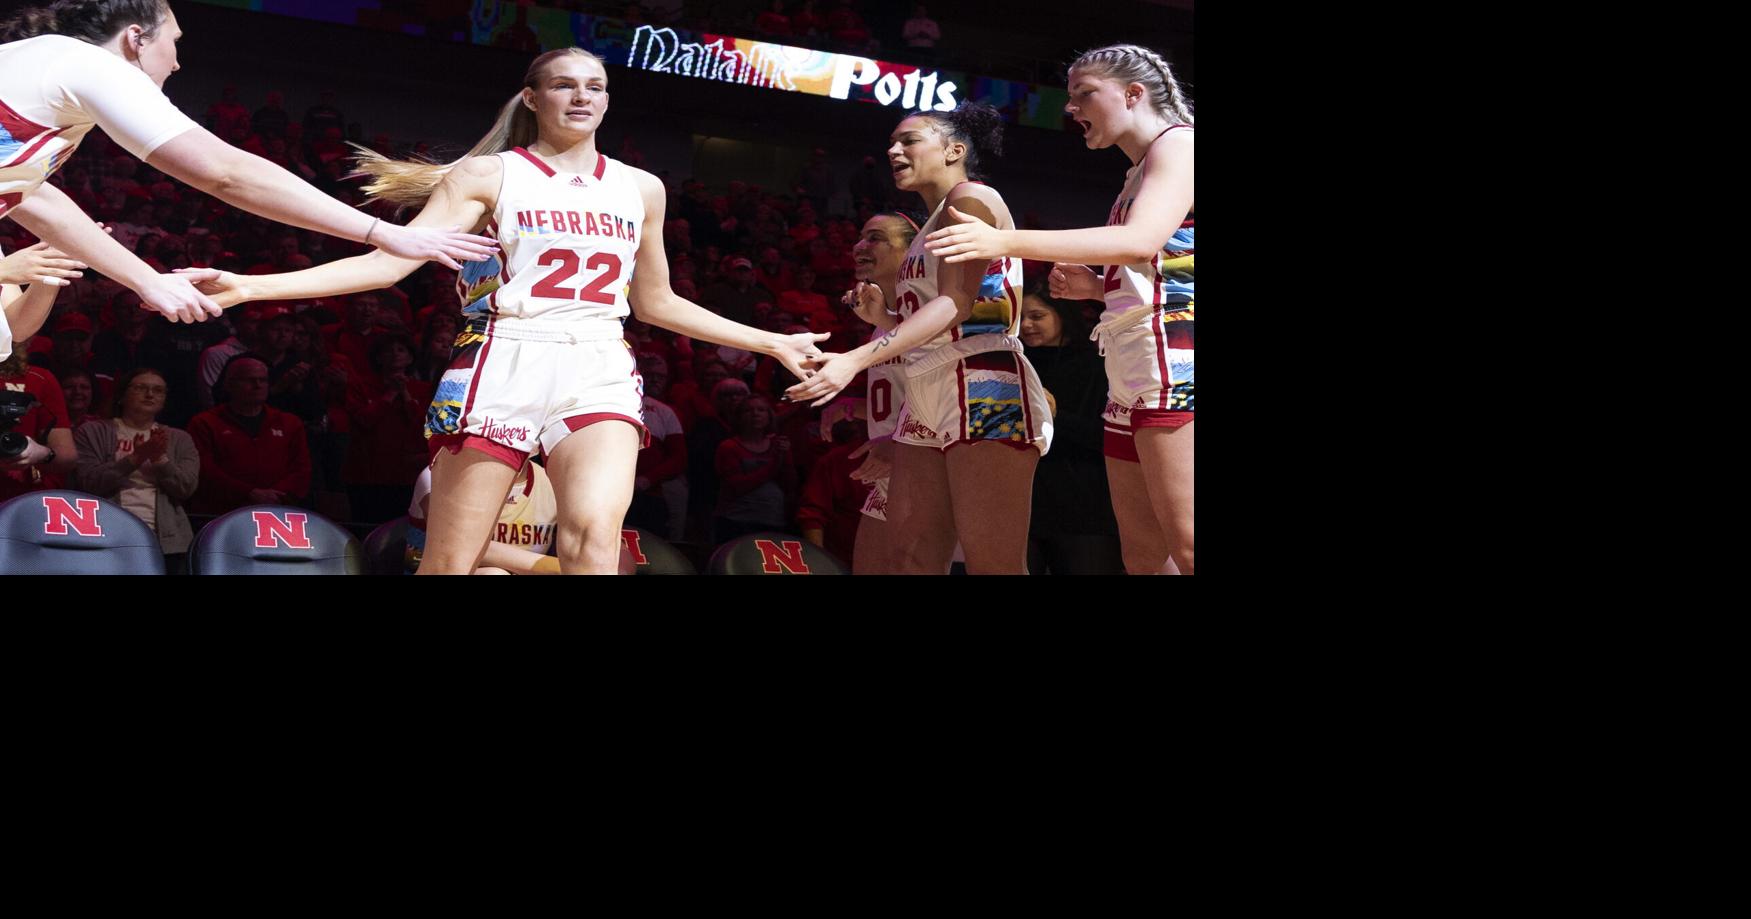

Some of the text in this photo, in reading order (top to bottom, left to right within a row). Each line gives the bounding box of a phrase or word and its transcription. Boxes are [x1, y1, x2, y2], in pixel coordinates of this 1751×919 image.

[829, 54, 957, 112] Potts
[517, 210, 635, 243] NEBRASKA
[530, 248, 622, 305] 22
[870, 378, 892, 423] 0
[479, 416, 530, 445] Huskers
[43, 496, 101, 537] N
[252, 511, 311, 549] N
[491, 522, 557, 545] RASKA
[755, 540, 810, 575] N
